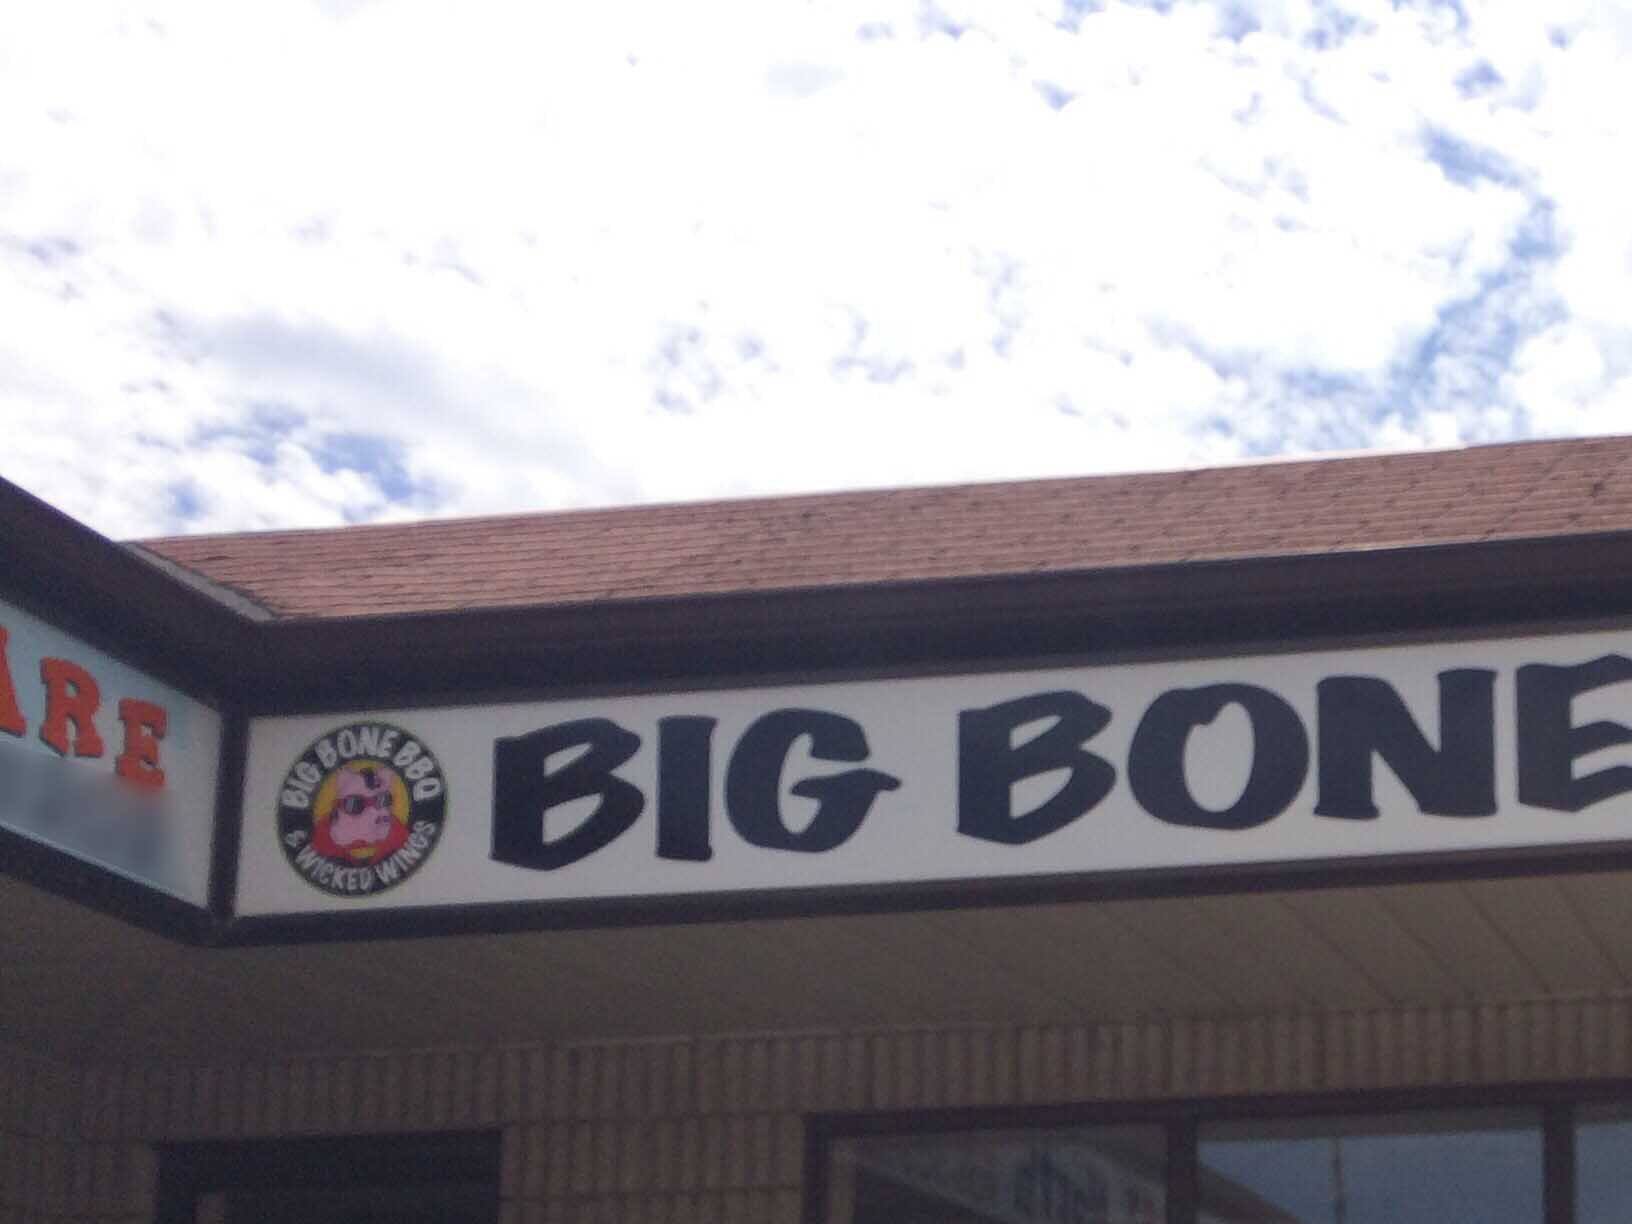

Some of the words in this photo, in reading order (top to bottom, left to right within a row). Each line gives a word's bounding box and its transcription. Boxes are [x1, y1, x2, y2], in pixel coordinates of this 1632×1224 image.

[282, 761, 321, 808] BIG
[315, 726, 400, 768] BONE
[393, 740, 441, 802] BBQ
[489, 707, 902, 872] BIG
[296, 846, 374, 891] WICKED
[374, 819, 437, 884] WINGS
